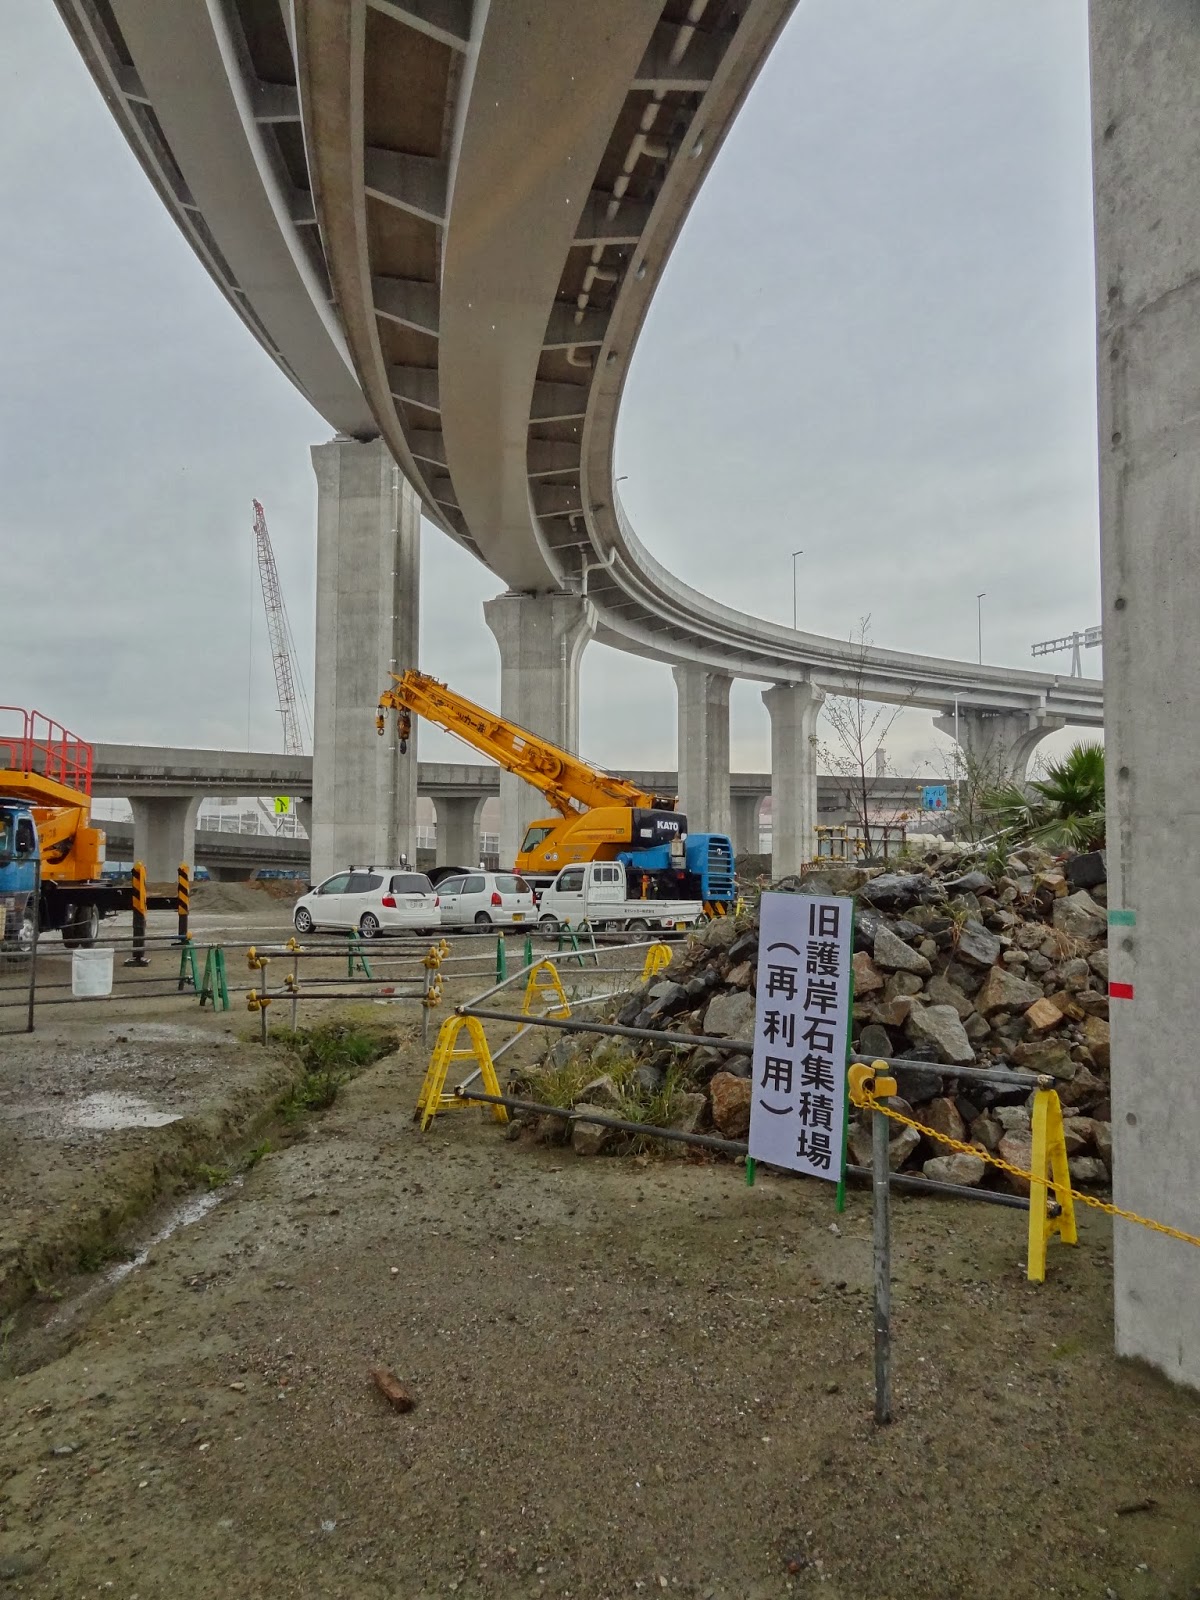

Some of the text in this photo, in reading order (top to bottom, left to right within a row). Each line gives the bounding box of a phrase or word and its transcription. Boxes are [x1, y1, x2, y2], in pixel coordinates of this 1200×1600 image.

[657, 820, 679, 831] KATO
[759, 942, 801, 1115] （再利用）
[796, 903, 840, 1170] 旧護岸石集積場
